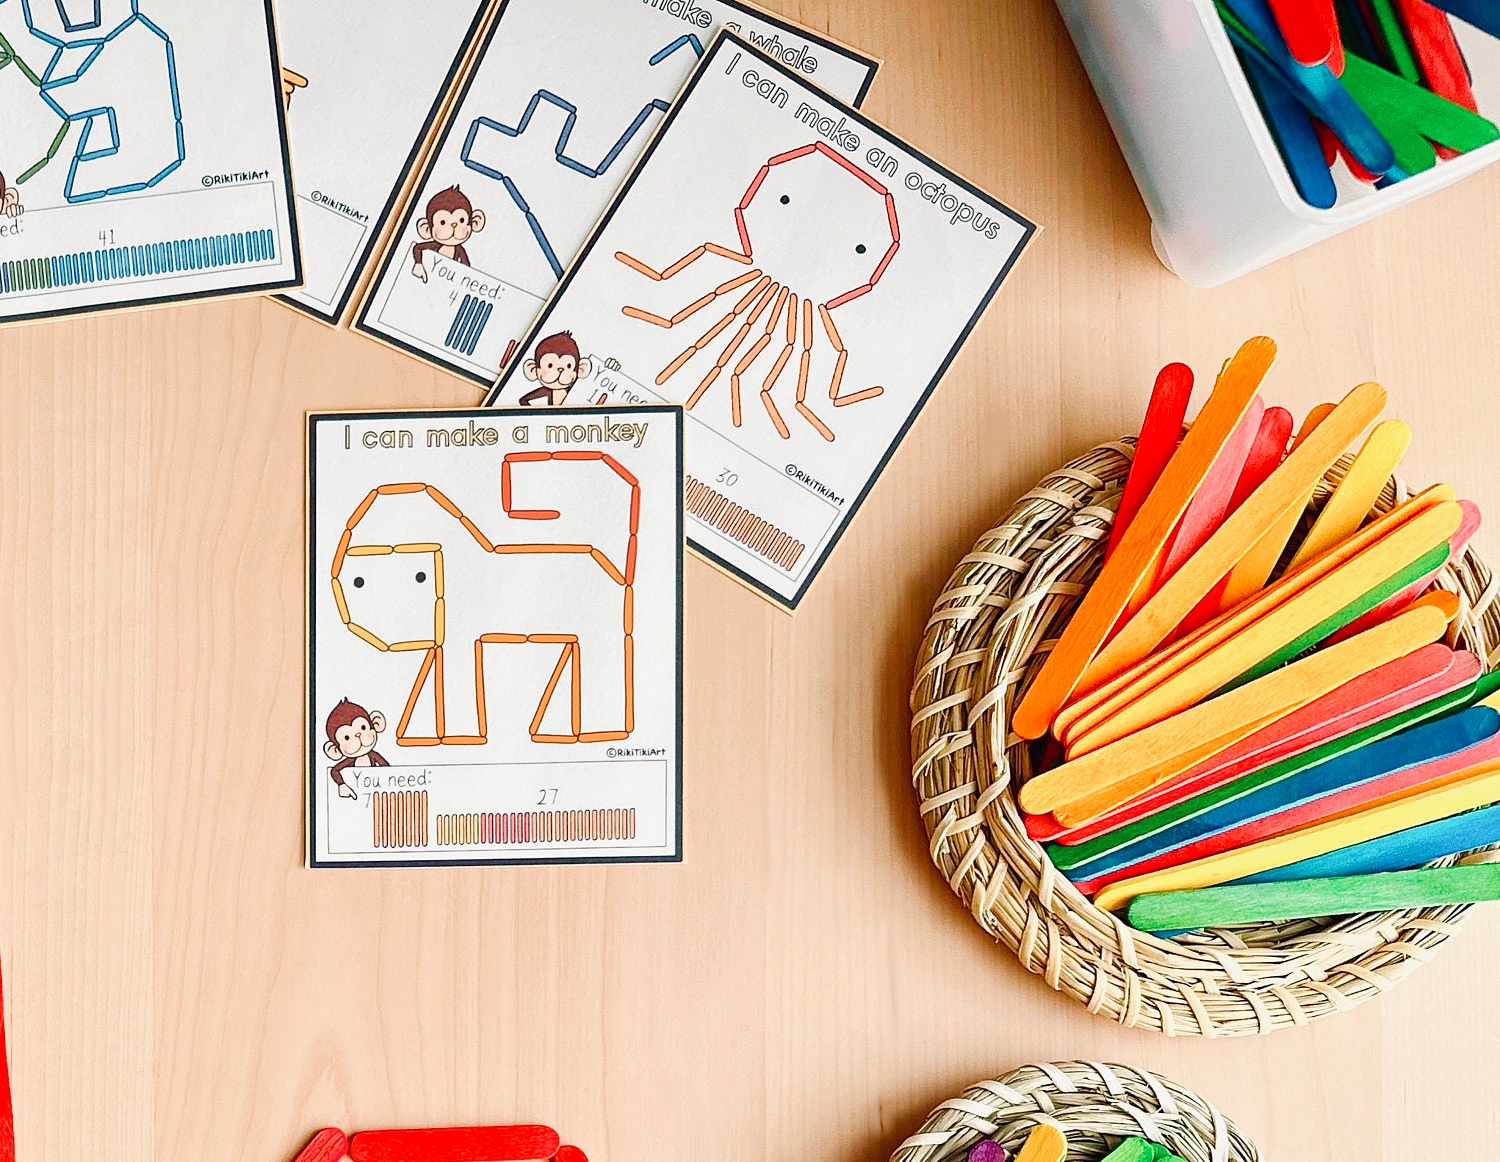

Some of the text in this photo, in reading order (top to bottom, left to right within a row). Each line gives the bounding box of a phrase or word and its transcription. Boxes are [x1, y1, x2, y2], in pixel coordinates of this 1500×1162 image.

[750, 31, 817, 73] whale
[725, 53, 1001, 240] I can make an octopus
[99, 230, 116, 246] 41
[430, 256, 505, 300] You need:
[449, 290, 458, 306] 4
[593, 365, 618, 394] You
[344, 416, 649, 449] I can make a monkey
[715, 467, 739, 487] 30
[352, 769, 432, 789] You need:
[364, 793, 372, 809] 7
[538, 789, 559, 805] 27
